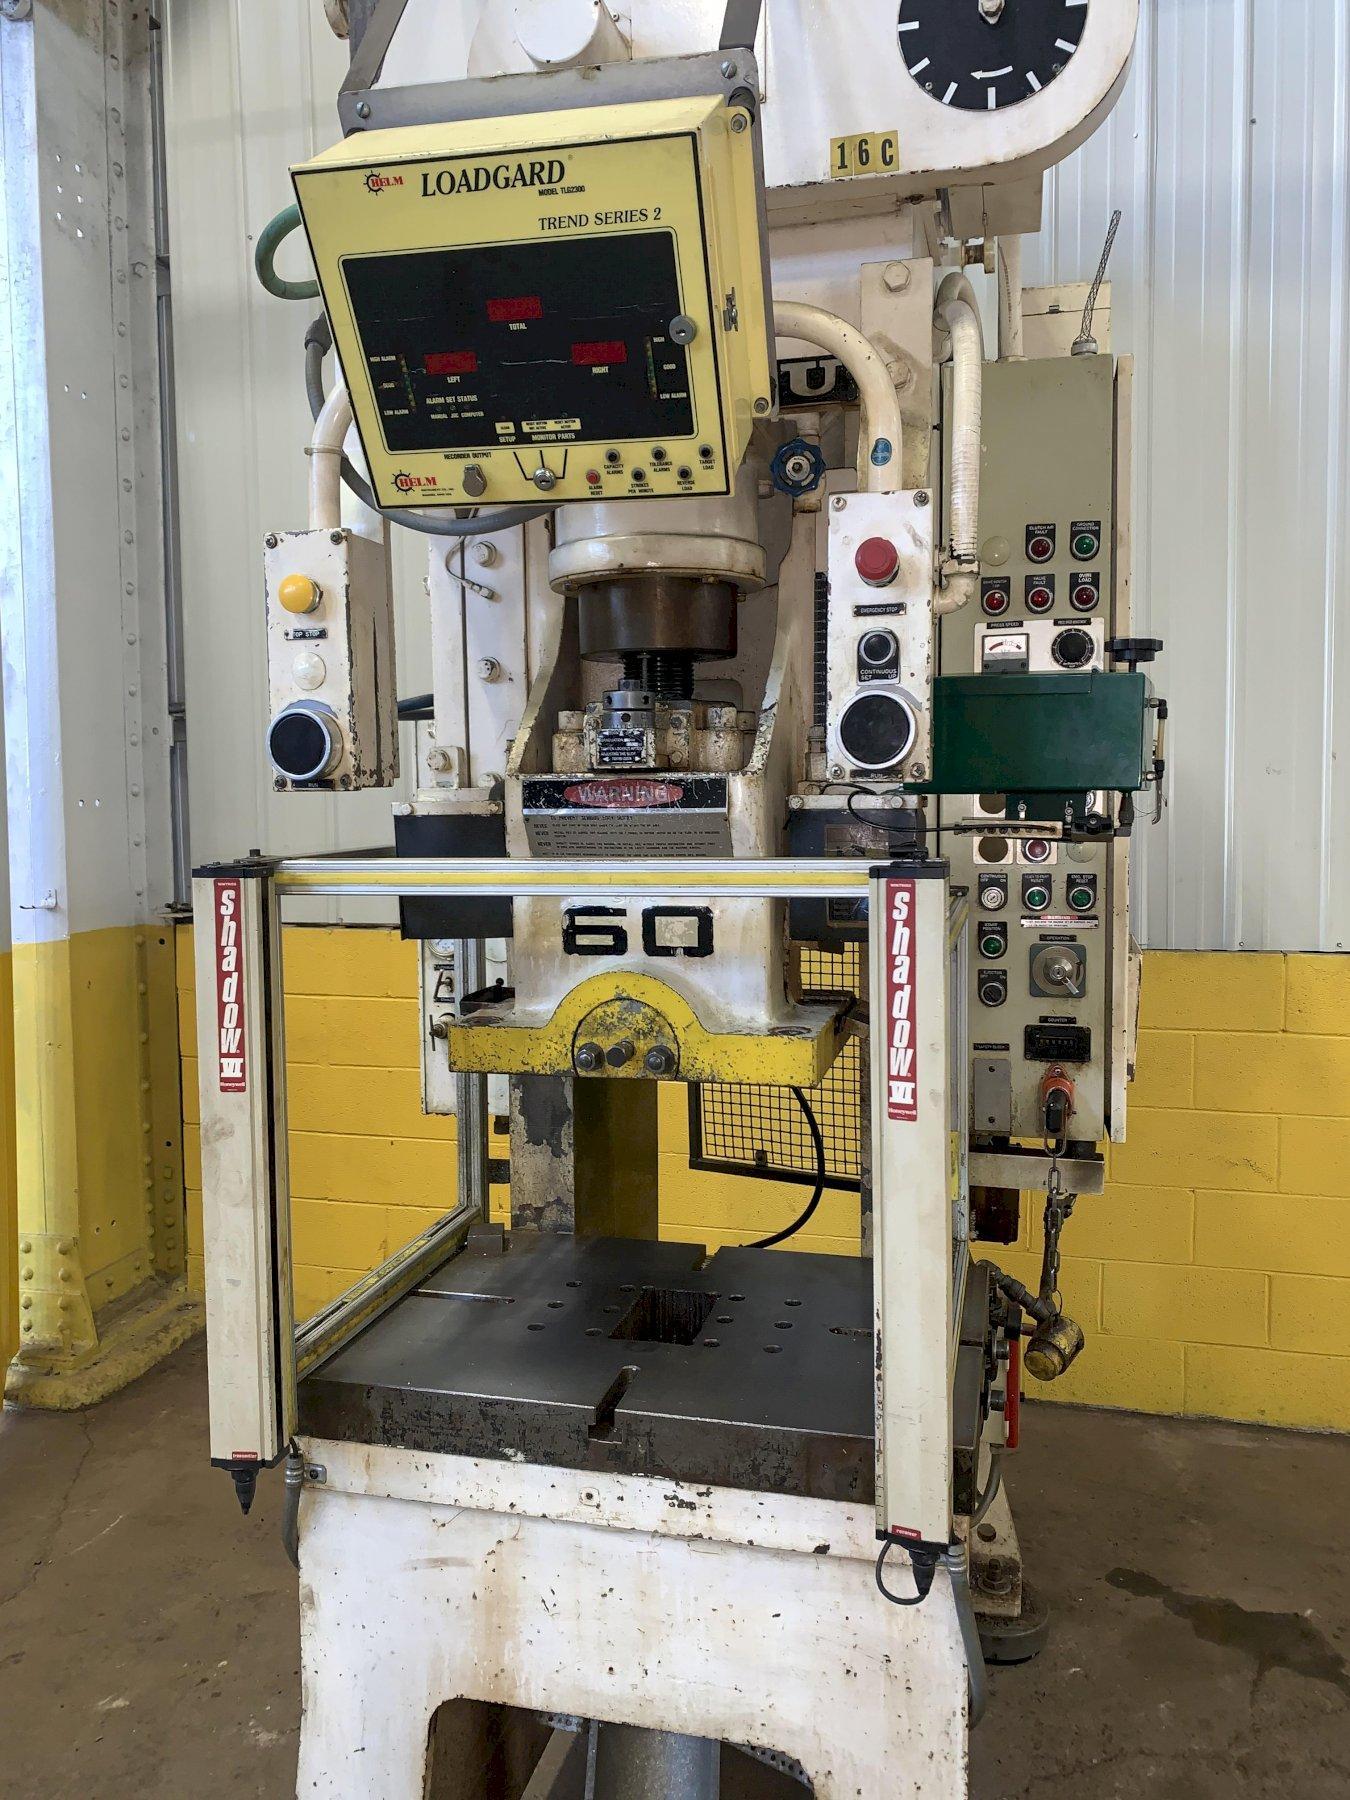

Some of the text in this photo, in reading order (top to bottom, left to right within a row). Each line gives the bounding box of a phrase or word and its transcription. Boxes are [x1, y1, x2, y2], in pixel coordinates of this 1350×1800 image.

[369, 174, 404, 188] HELM
[421, 159, 566, 197] LOADGARD
[538, 187, 559, 197] MODEL
[538, 207, 662, 231] TREND SERIES 2
[508, 322, 528, 330] TOTAL
[591, 365, 610, 373] RIGHT
[446, 375, 461, 383] LEFT
[425, 394, 479, 404] ALARM SET STATUS
[499, 435, 517, 443] SETUP
[531, 432, 577, 441] MONITOR PARTS
[399, 476, 438, 488] HELM
[860, 605, 899, 614] EMERGENCY STOP
[578, 785, 670, 803] WARNING
[561, 905, 715, 957] 60
